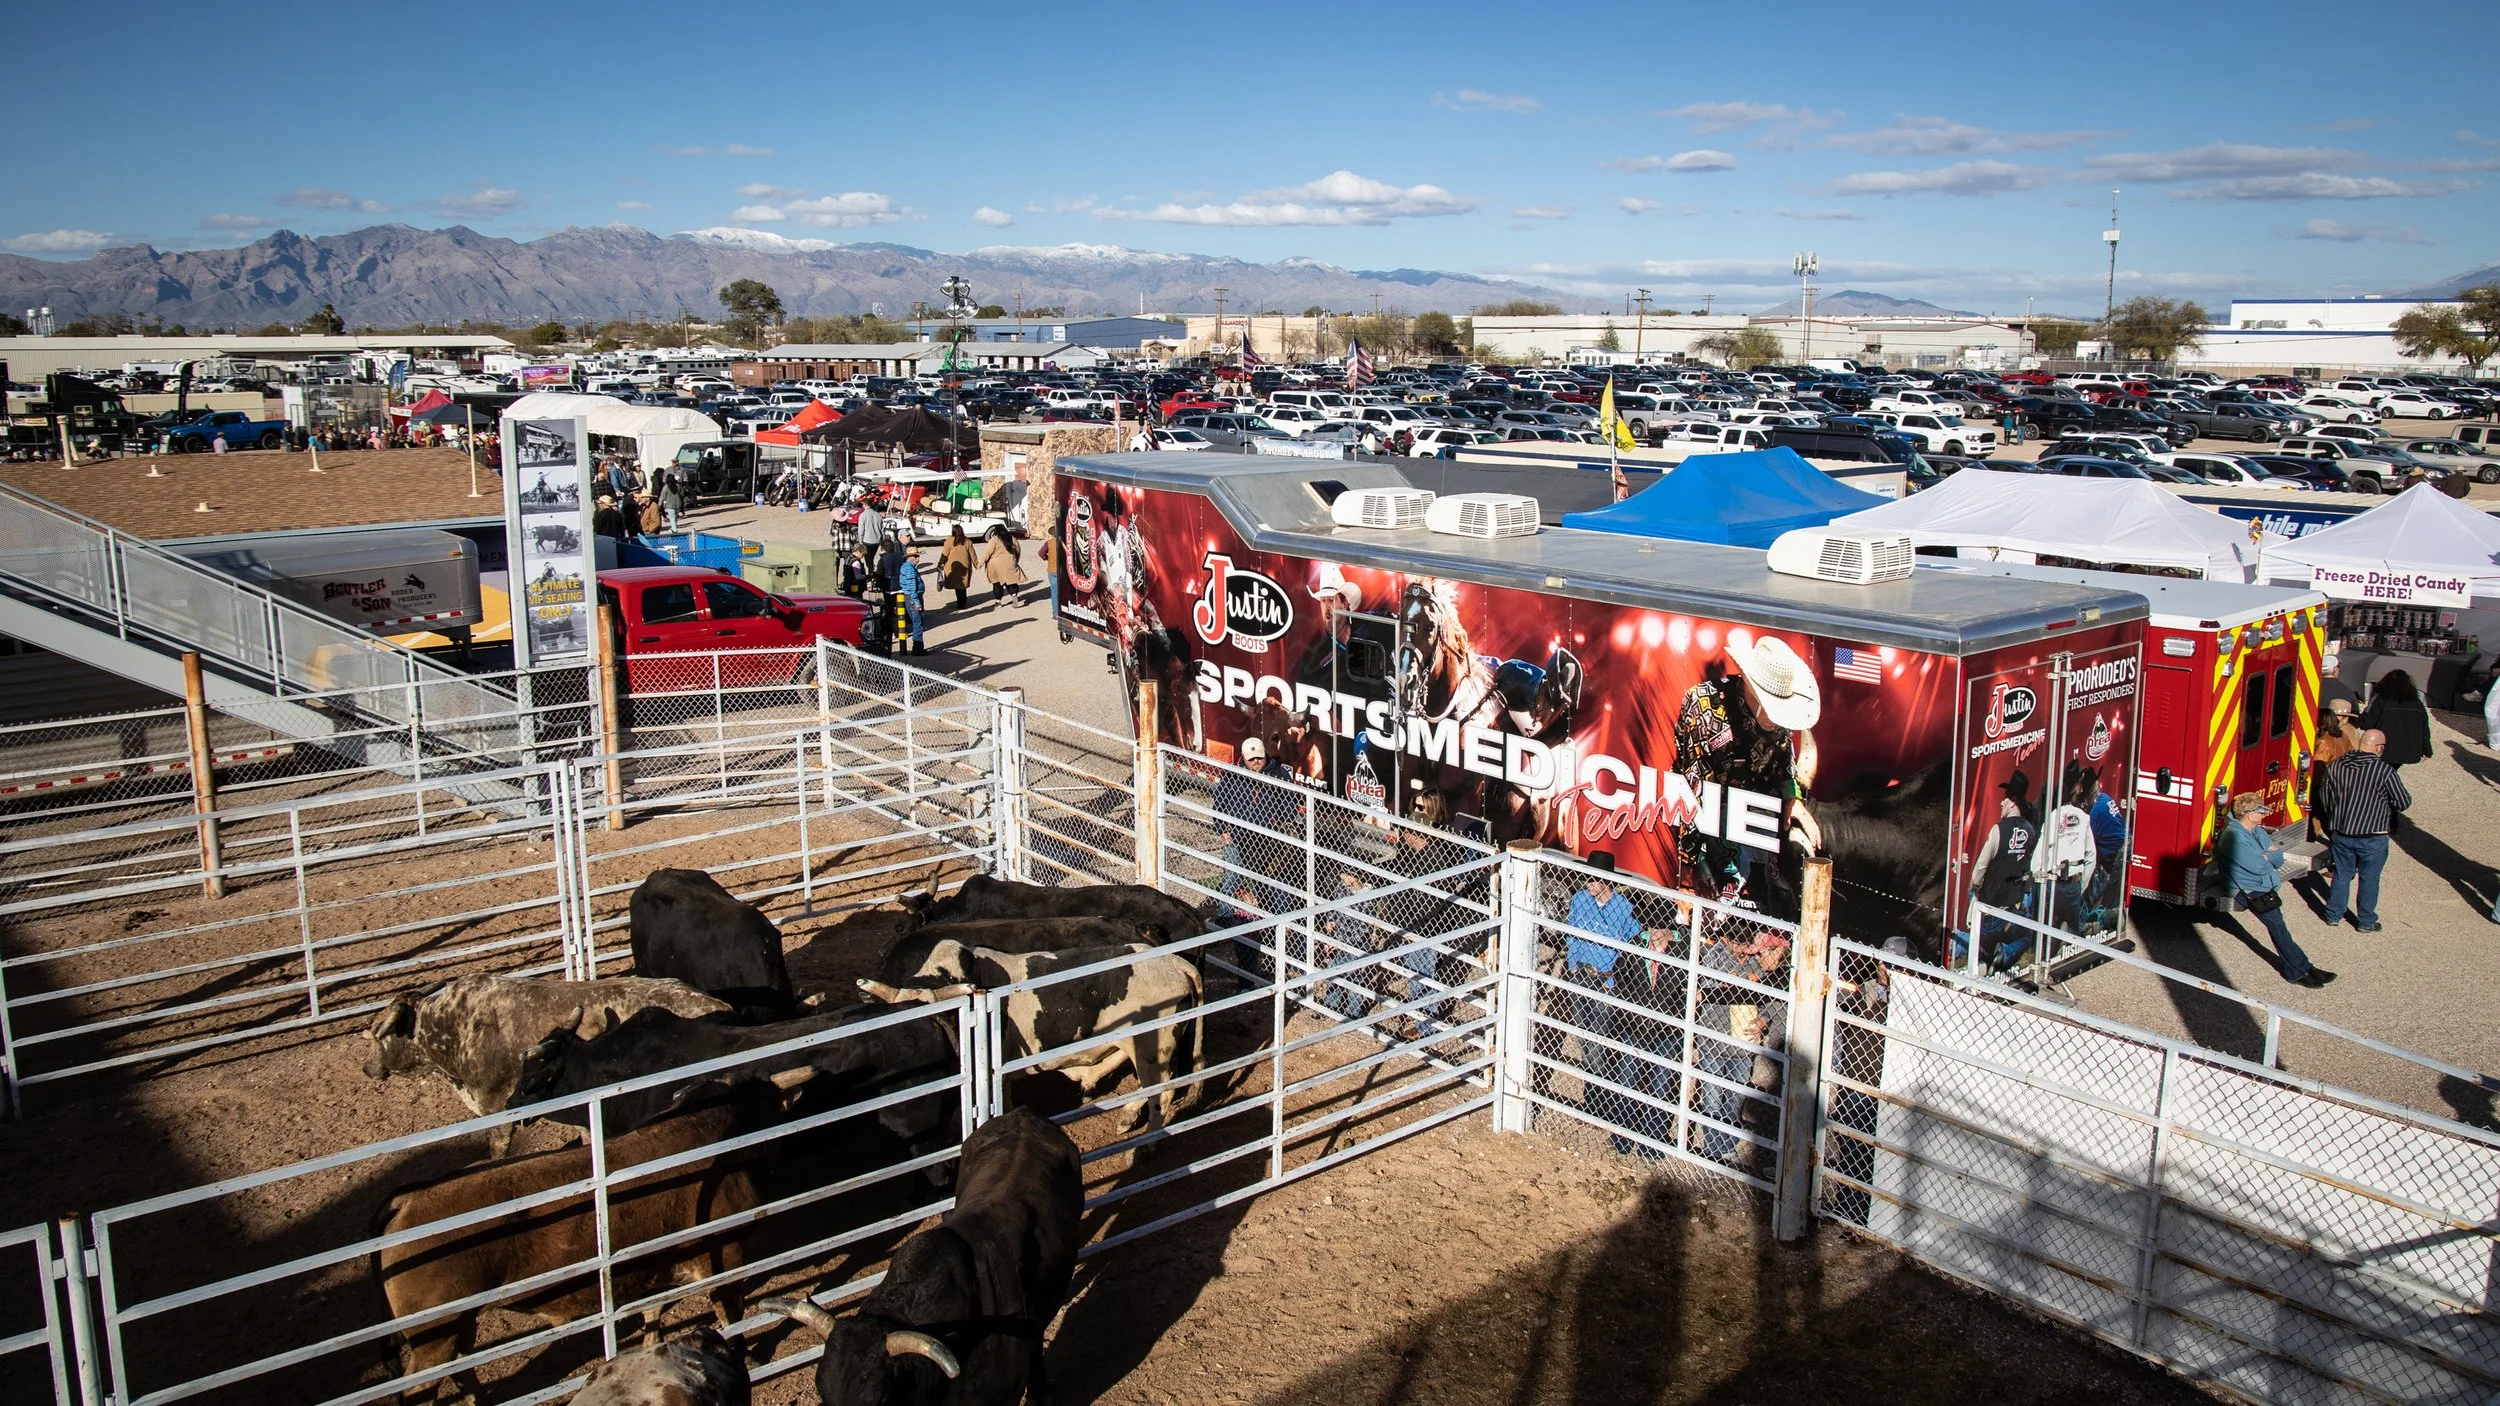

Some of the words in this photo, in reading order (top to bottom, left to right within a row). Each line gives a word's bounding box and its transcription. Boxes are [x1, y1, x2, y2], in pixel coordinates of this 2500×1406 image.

[1302, 447, 1335, 459] AROUND
[2262, 514, 2299, 536] bile
[1066, 522, 1077, 582] COWBOY
[529, 579, 579, 592] ULTIMATE
[2315, 568, 2364, 583] Freeze
[2368, 572, 2410, 587] Dried
[2415, 575, 2466, 594] Candy
[391, 588, 413, 596] RODEO
[398, 593, 437, 603] PRODUCERS
[529, 595, 543, 605] VIP
[546, 591, 583, 604] SEATING
[1195, 556, 1284, 643] Justin
[2364, 585, 2412, 600] HERE!
[540, 605, 572, 619] ONLY
[1234, 633, 1265, 650] BOOTS
[2068, 656, 2136, 695] PRORODEO'S
[2067, 697, 2088, 711] FIRST
[2089, 683, 2135, 706] RESPONDERS
[1986, 685, 2032, 738] Justin
[2005, 722, 2023, 732] BOOTS
[1971, 728, 2046, 759] SPORTSMEDICINE
[2013, 736, 2046, 767] Team
[1195, 658, 1783, 854] SPORTSMEDICINE
[1295, 772, 1328, 790] RAM
[2266, 779, 2288, 799] Fire
[1552, 782, 1698, 848] Team
